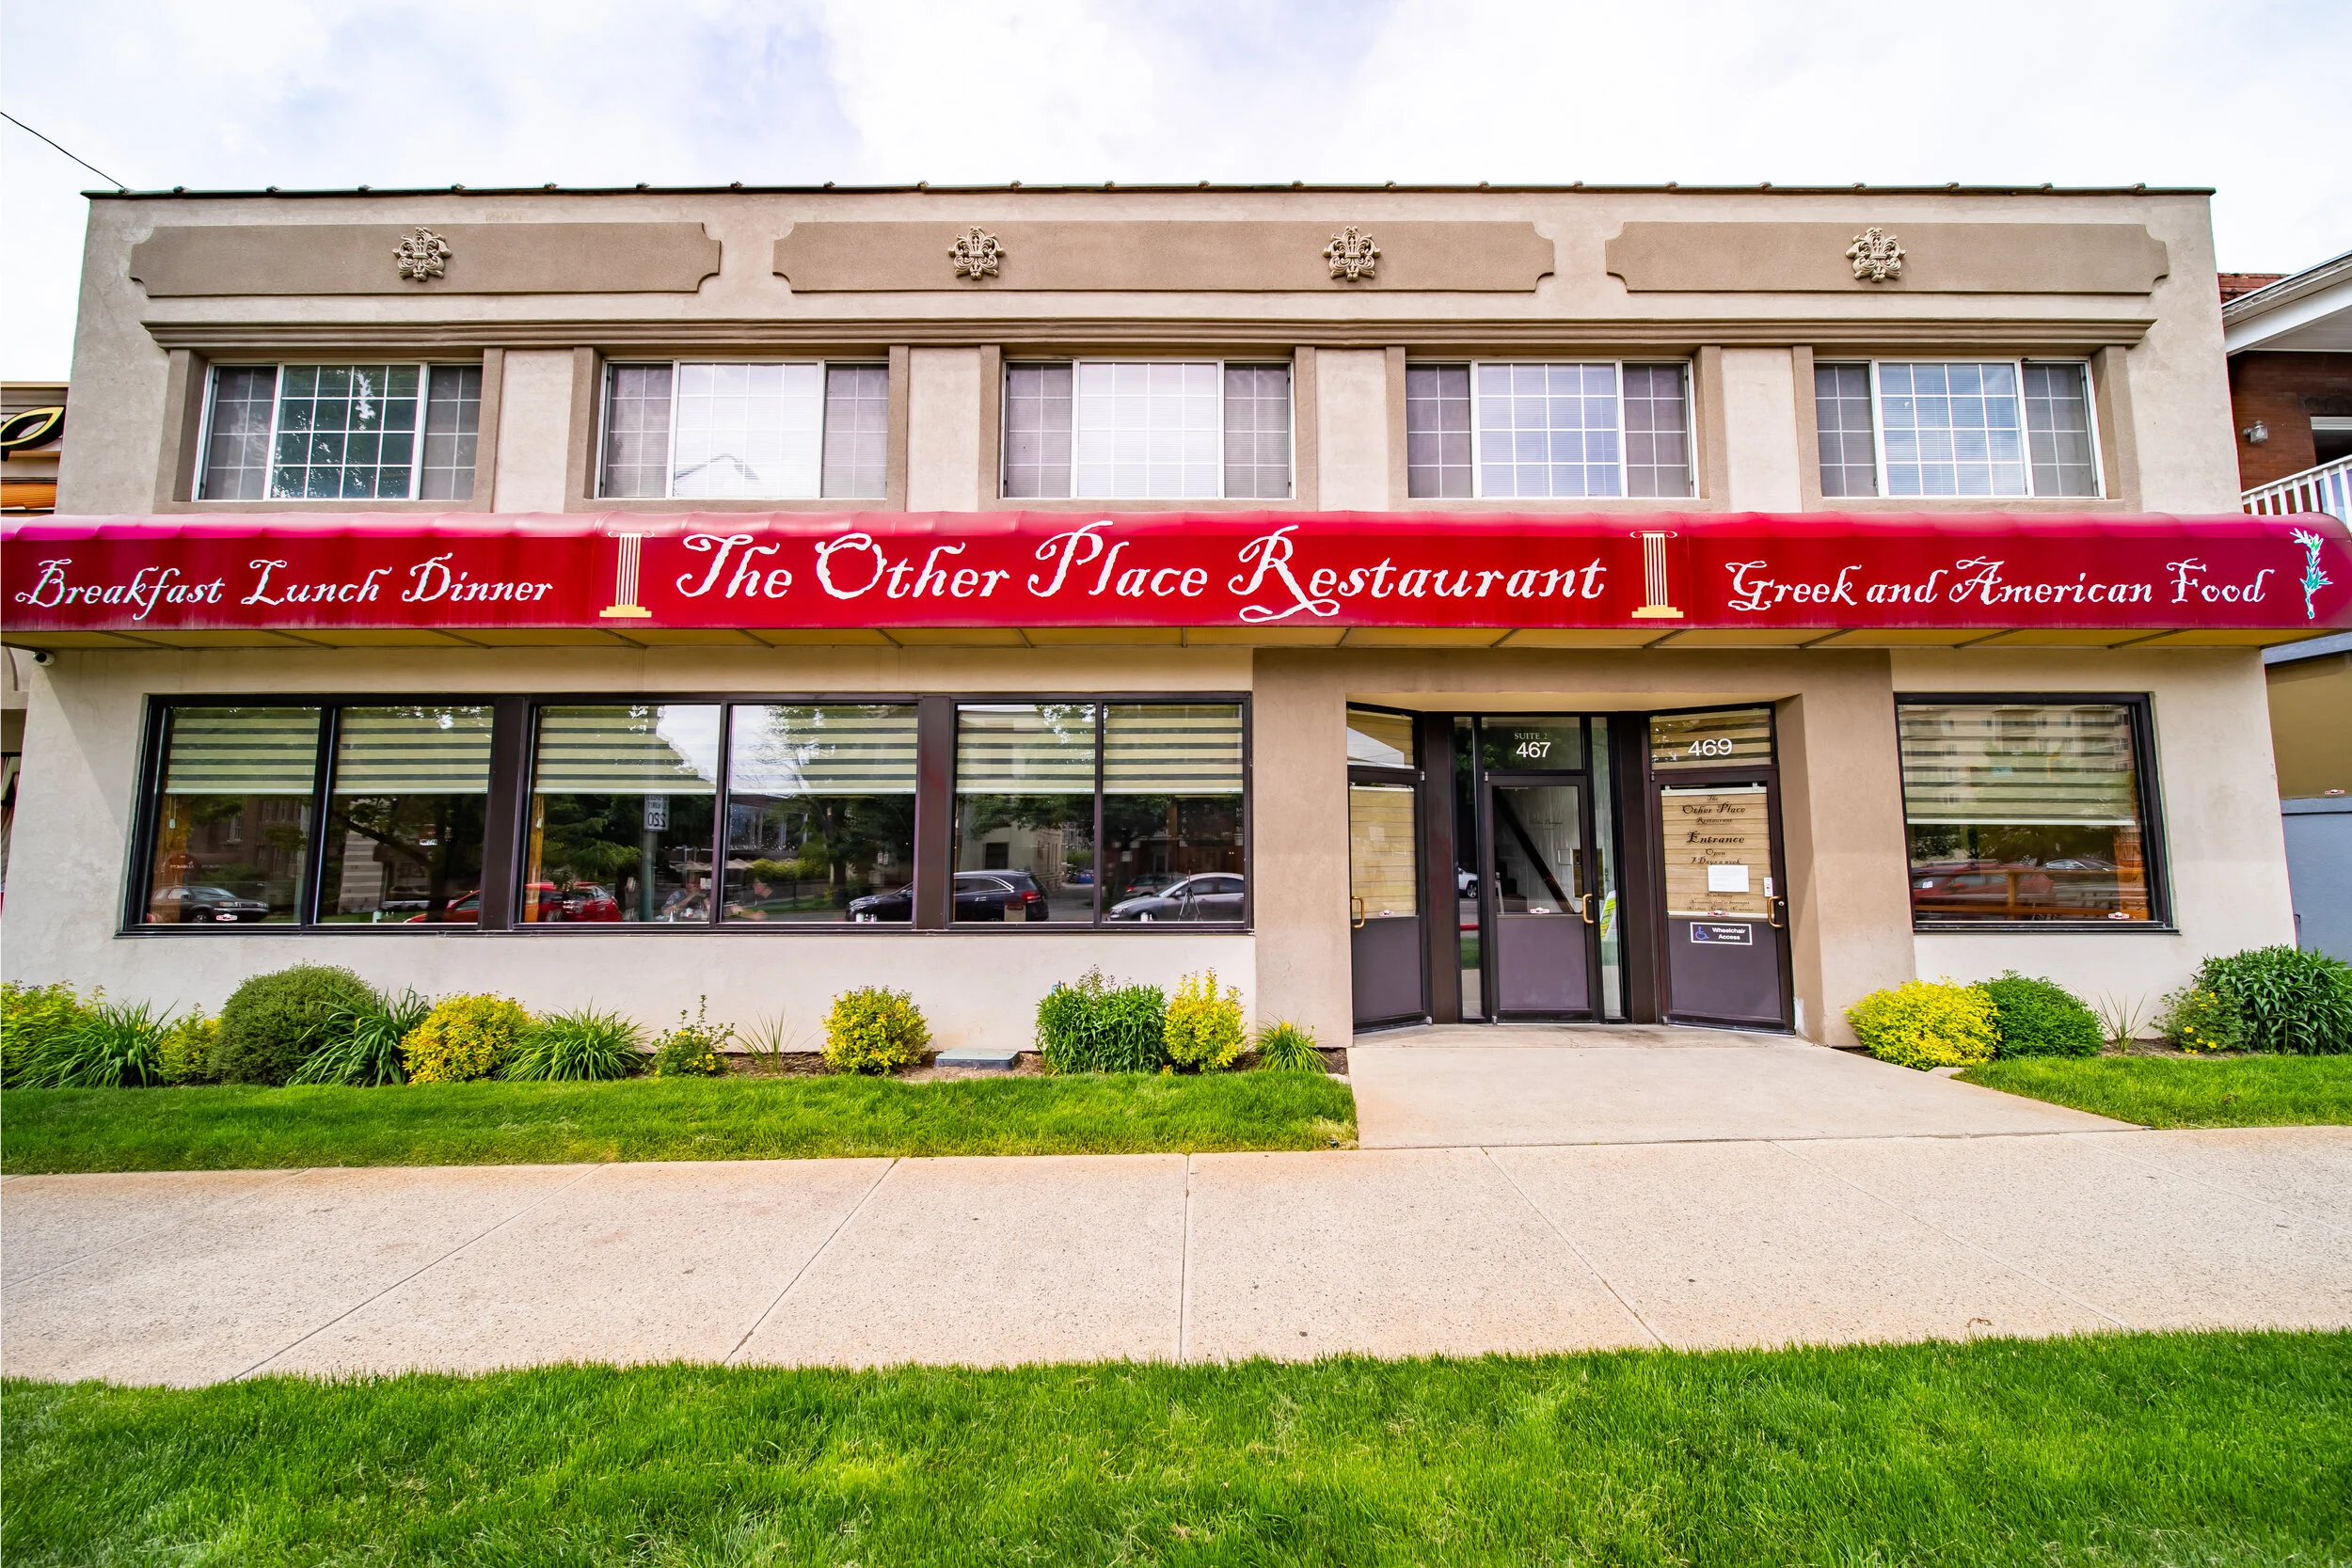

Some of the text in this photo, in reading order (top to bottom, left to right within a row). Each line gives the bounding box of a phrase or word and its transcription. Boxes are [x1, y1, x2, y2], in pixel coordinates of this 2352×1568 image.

[675, 520, 1607, 624] The Other Place Restaurant
[15, 552, 553, 620] Breakfast Lunch Dinner
[1724, 555, 2275, 611] Greek and American Food
[1514, 732, 1541, 740] SUITE
[1516, 741, 1551, 758] 467
[1687, 737, 1733, 757] 469
[1682, 801, 1746, 815] Other Place
[1686, 831, 1745, 845] Entrance
[1705, 848, 1726, 857] Open
